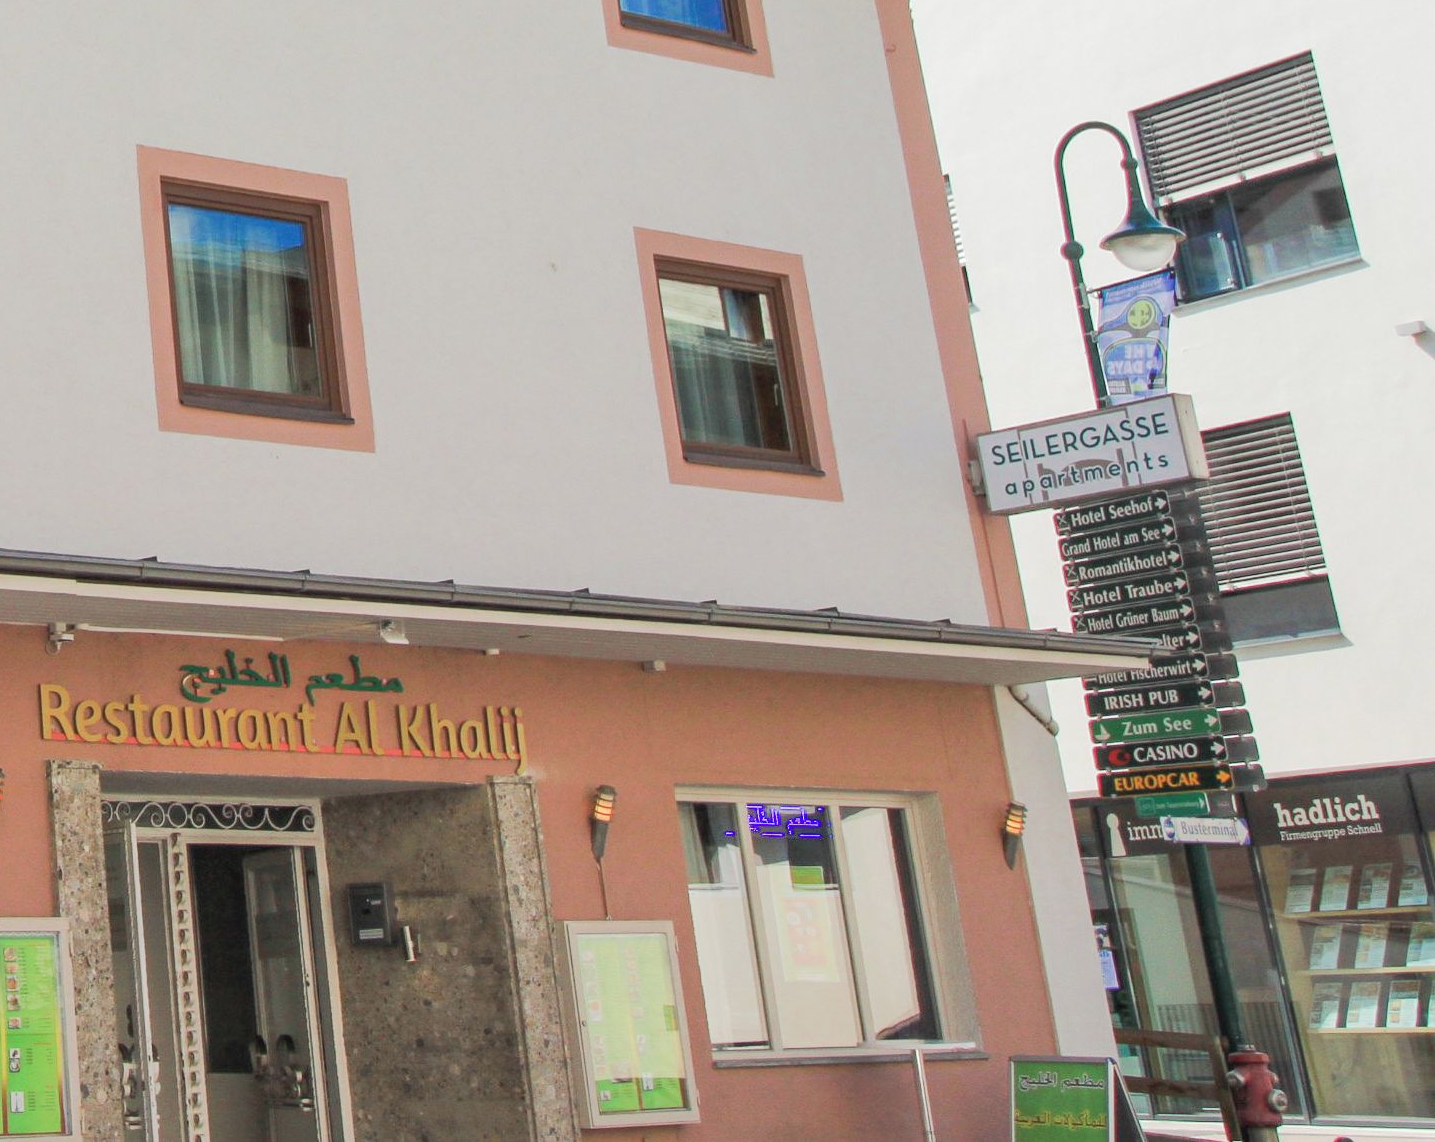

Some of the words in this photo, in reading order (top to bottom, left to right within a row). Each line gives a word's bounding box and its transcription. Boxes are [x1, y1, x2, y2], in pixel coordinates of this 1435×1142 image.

[991, 412, 1169, 466] SEILERGASSE
[1005, 452, 1169, 498] apartments
[1071, 507, 1105, 527] Hotel
[1108, 497, 1153, 519] Seehof
[1061, 540, 1091, 557] Grand
[1093, 532, 1121, 552] Hotel
[1124, 533, 1140, 545] am
[1141, 527, 1160, 541] See
[1078, 551, 1167, 580] Romantikhotel
[1083, 586, 1121, 606] Hotel
[1125, 580, 1173, 599] Traube
[1087, 615, 1114, 632] Hotel
[1116, 611, 1149, 628] Grüner
[1152, 608, 1180, 623] Baum
[1156, 634, 1185, 648] elter
[179, 649, 290, 702] الخليج
[306, 655, 404, 704] مطعم
[1104, 695, 1144, 710] IRISH
[1149, 689, 1179, 705] PUB
[39, 683, 319, 753] Restaurant
[335, 698, 384, 756] Al
[396, 702, 529, 775] Khalij
[1122, 721, 1158, 736] Zum
[1163, 717, 1192, 732] See
[1133, 742, 1198, 763] CASINO
[1114, 771, 1200, 792] EUROPCAR
[1273, 794, 1380, 827] hadlich
[1127, 821, 1164, 841] imm
[1180, 821, 1238, 837] Busterminal
[1280, 828, 1346, 841] Firmengruppe
[1347, 823, 1382, 835] Schnell
